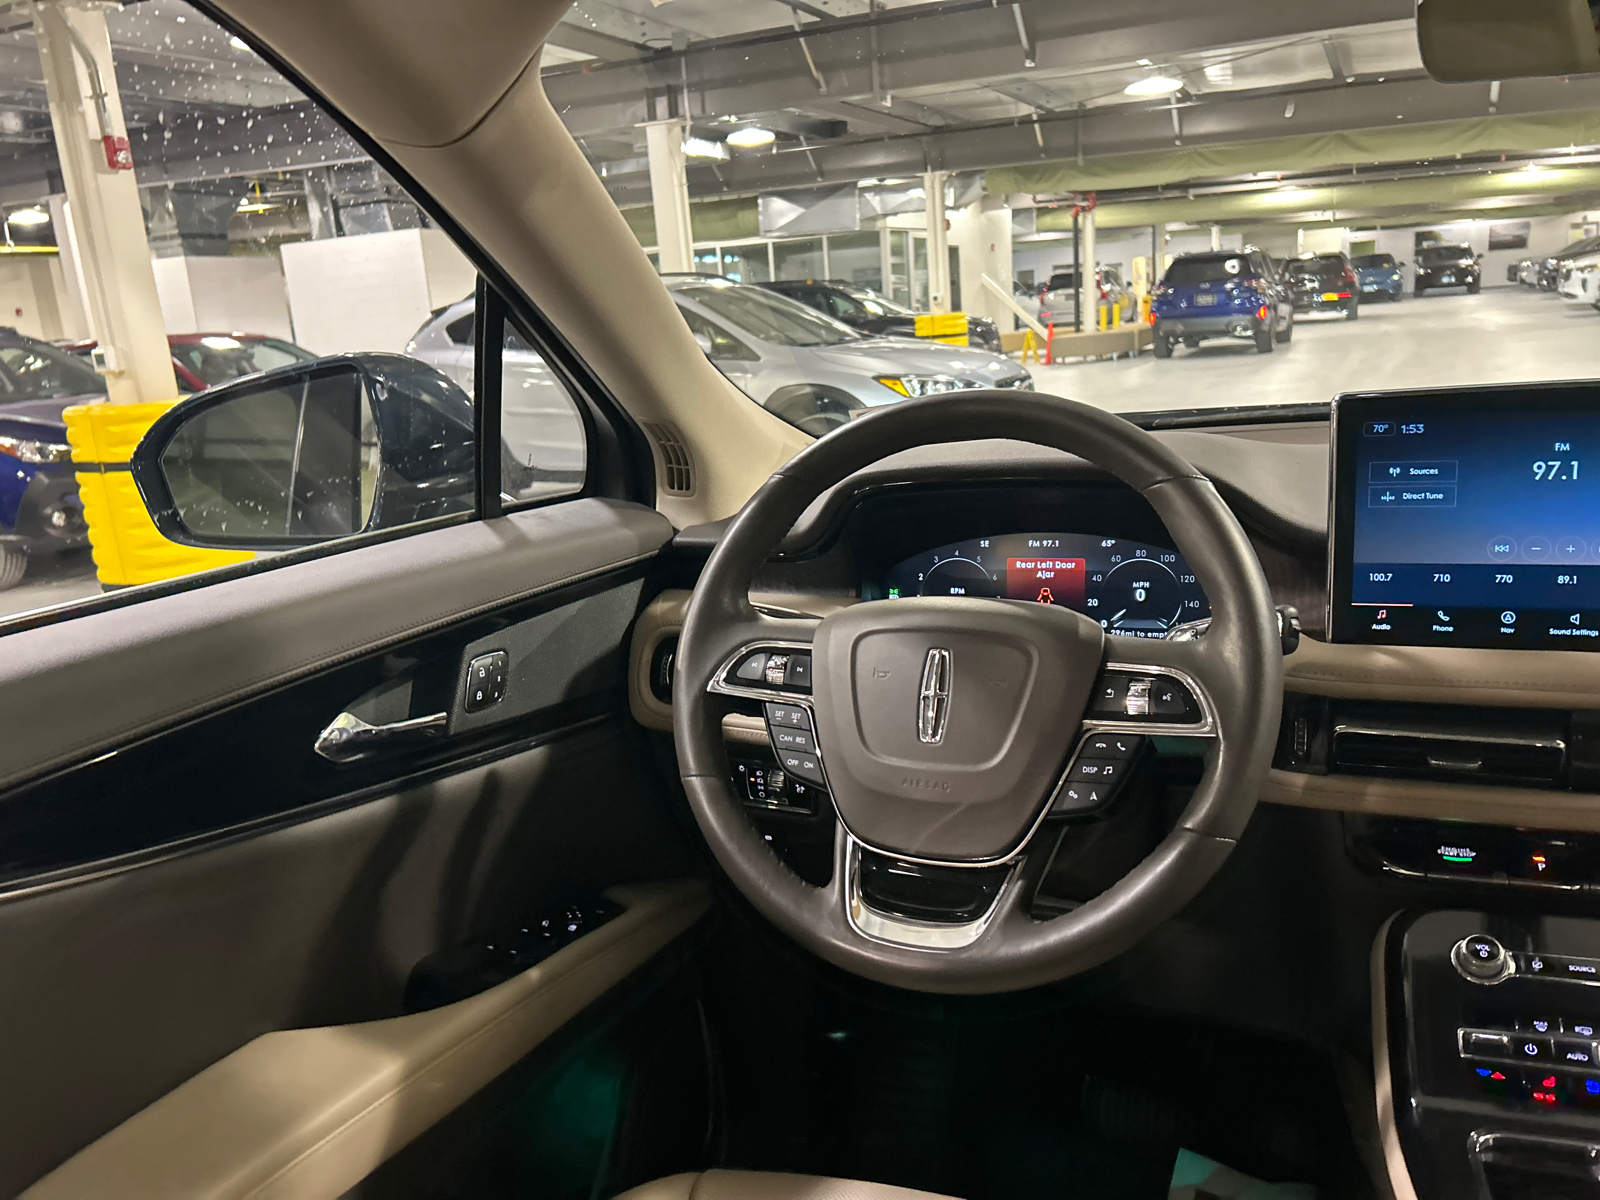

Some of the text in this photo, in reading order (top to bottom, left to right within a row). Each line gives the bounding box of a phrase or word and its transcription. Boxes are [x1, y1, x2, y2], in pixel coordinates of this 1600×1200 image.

[1401, 424, 1424, 434] 1:53
[1555, 443, 1570, 451] FM
[1409, 467, 1439, 475] Sources
[1532, 460, 1579, 481] 97.1
[1402, 492, 1444, 500] Direct Tune
[980, 540, 990, 548] SE
[1028, 540, 1060, 548] FM 97.1
[1135, 549, 1147, 557] 80
[933, 555, 939, 563] 3
[976, 555, 982, 563] 5
[1111, 554, 1122, 563] 60
[1160, 554, 1176, 563] 100
[1016, 561, 1076, 569] Rear Left Door
[918, 572, 924, 581] 2
[993, 573, 998, 581] 6
[1036, 570, 1055, 579] Ajar
[1091, 574, 1103, 582] 40
[1180, 575, 1195, 583] 120
[1369, 573, 1393, 581] 100.7
[1433, 573, 1451, 583] 710
[1495, 574, 1514, 584] 770
[1557, 575, 1578, 584] 89.1
[1135, 588, 1146, 602] 0
[1087, 598, 1099, 607] 20
[1184, 600, 1200, 608] 140
[1101, 619, 1108, 628] 0
[1137, 630, 1144, 638] to
[1549, 628, 1599, 637] Sound Settings
[774, 710, 801, 720] SET SET
[779, 734, 806, 745] CAN RES
[787, 758, 814, 769] OFF ON
[1082, 766, 1098, 774] DISP
[1475, 944, 1491, 952] VOL
[1568, 964, 1597, 974] SOURCE
[1566, 1052, 1589, 1062] AUTO
